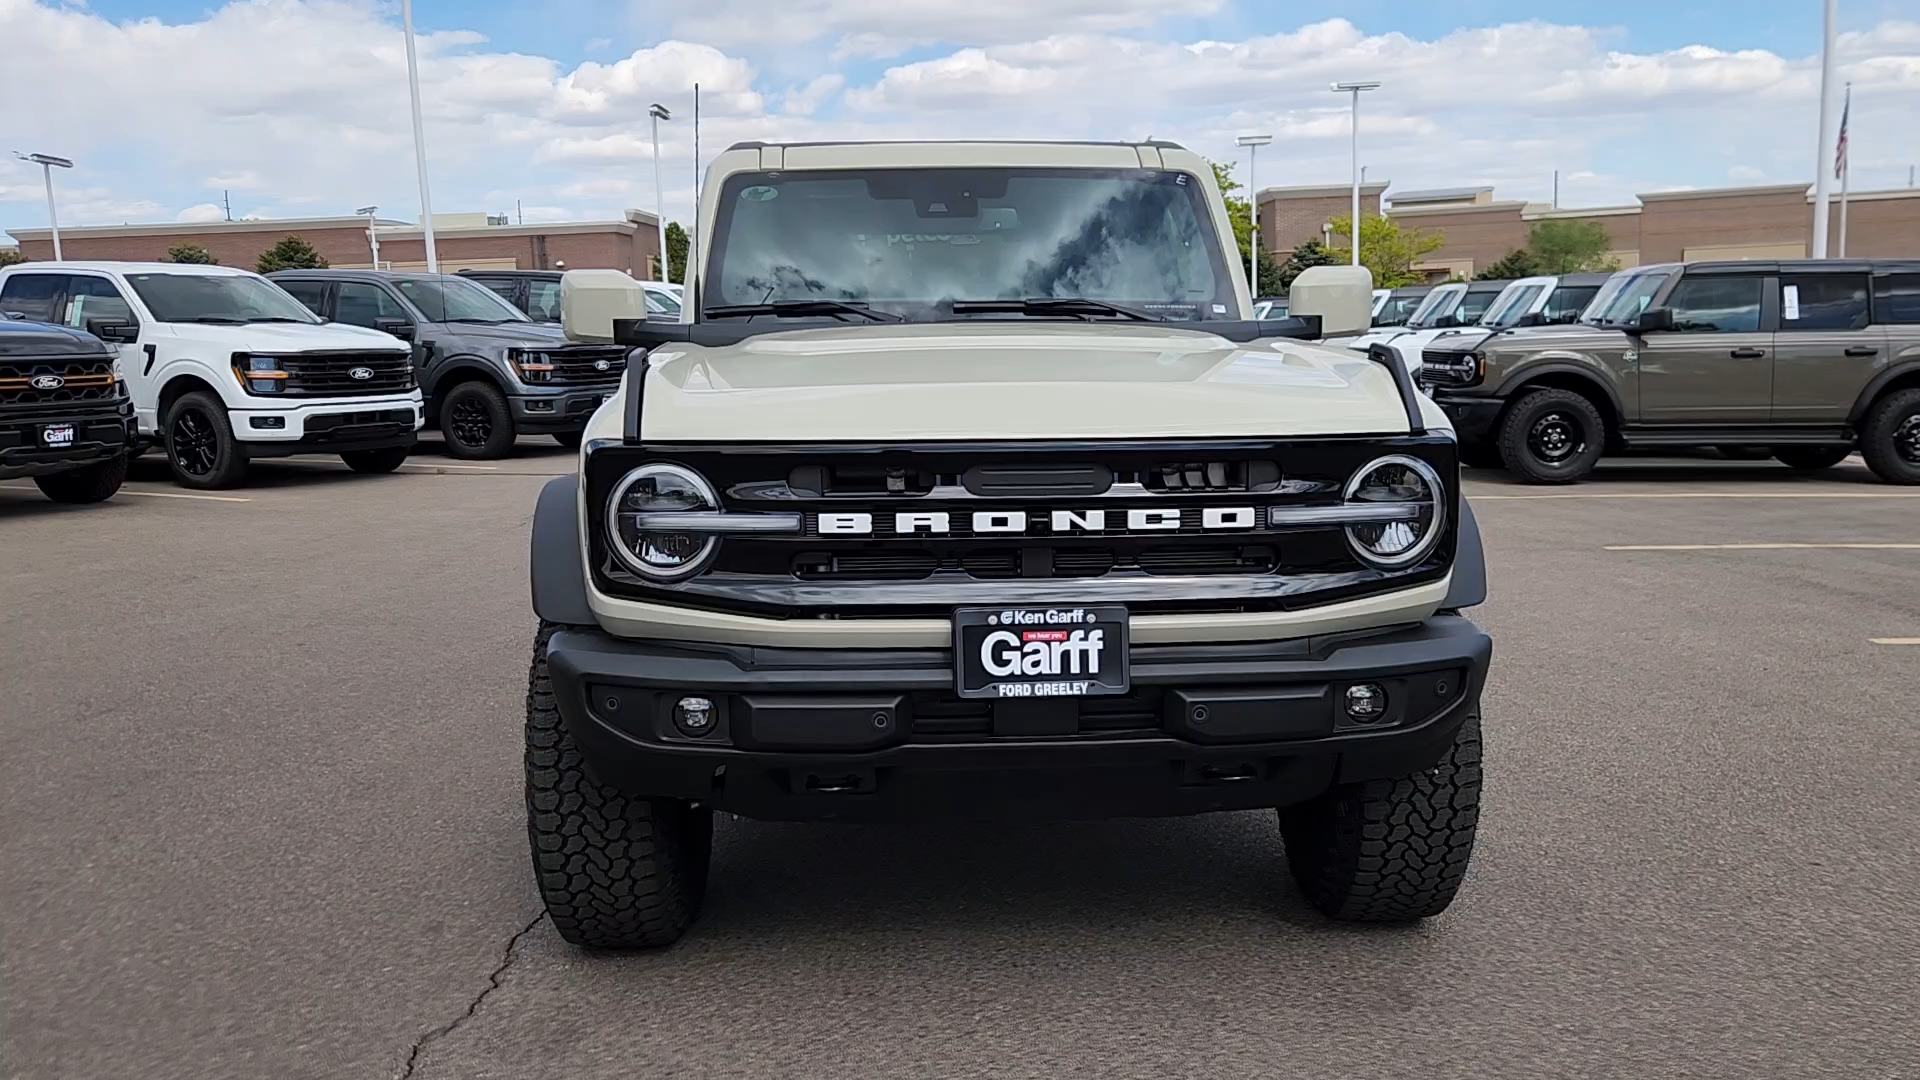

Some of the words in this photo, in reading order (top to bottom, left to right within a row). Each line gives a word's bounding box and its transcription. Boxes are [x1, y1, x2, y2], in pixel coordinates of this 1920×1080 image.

[35, 376, 61, 388] Ford
[43, 428, 74, 442] Garff
[818, 507, 1256, 534] BRONCO
[1014, 610, 1044, 624] Ken
[1045, 609, 1084, 624] Garff
[980, 629, 1104, 677] Garff
[999, 684, 1032, 697] FORD
[1034, 682, 1089, 696] GREELEY
